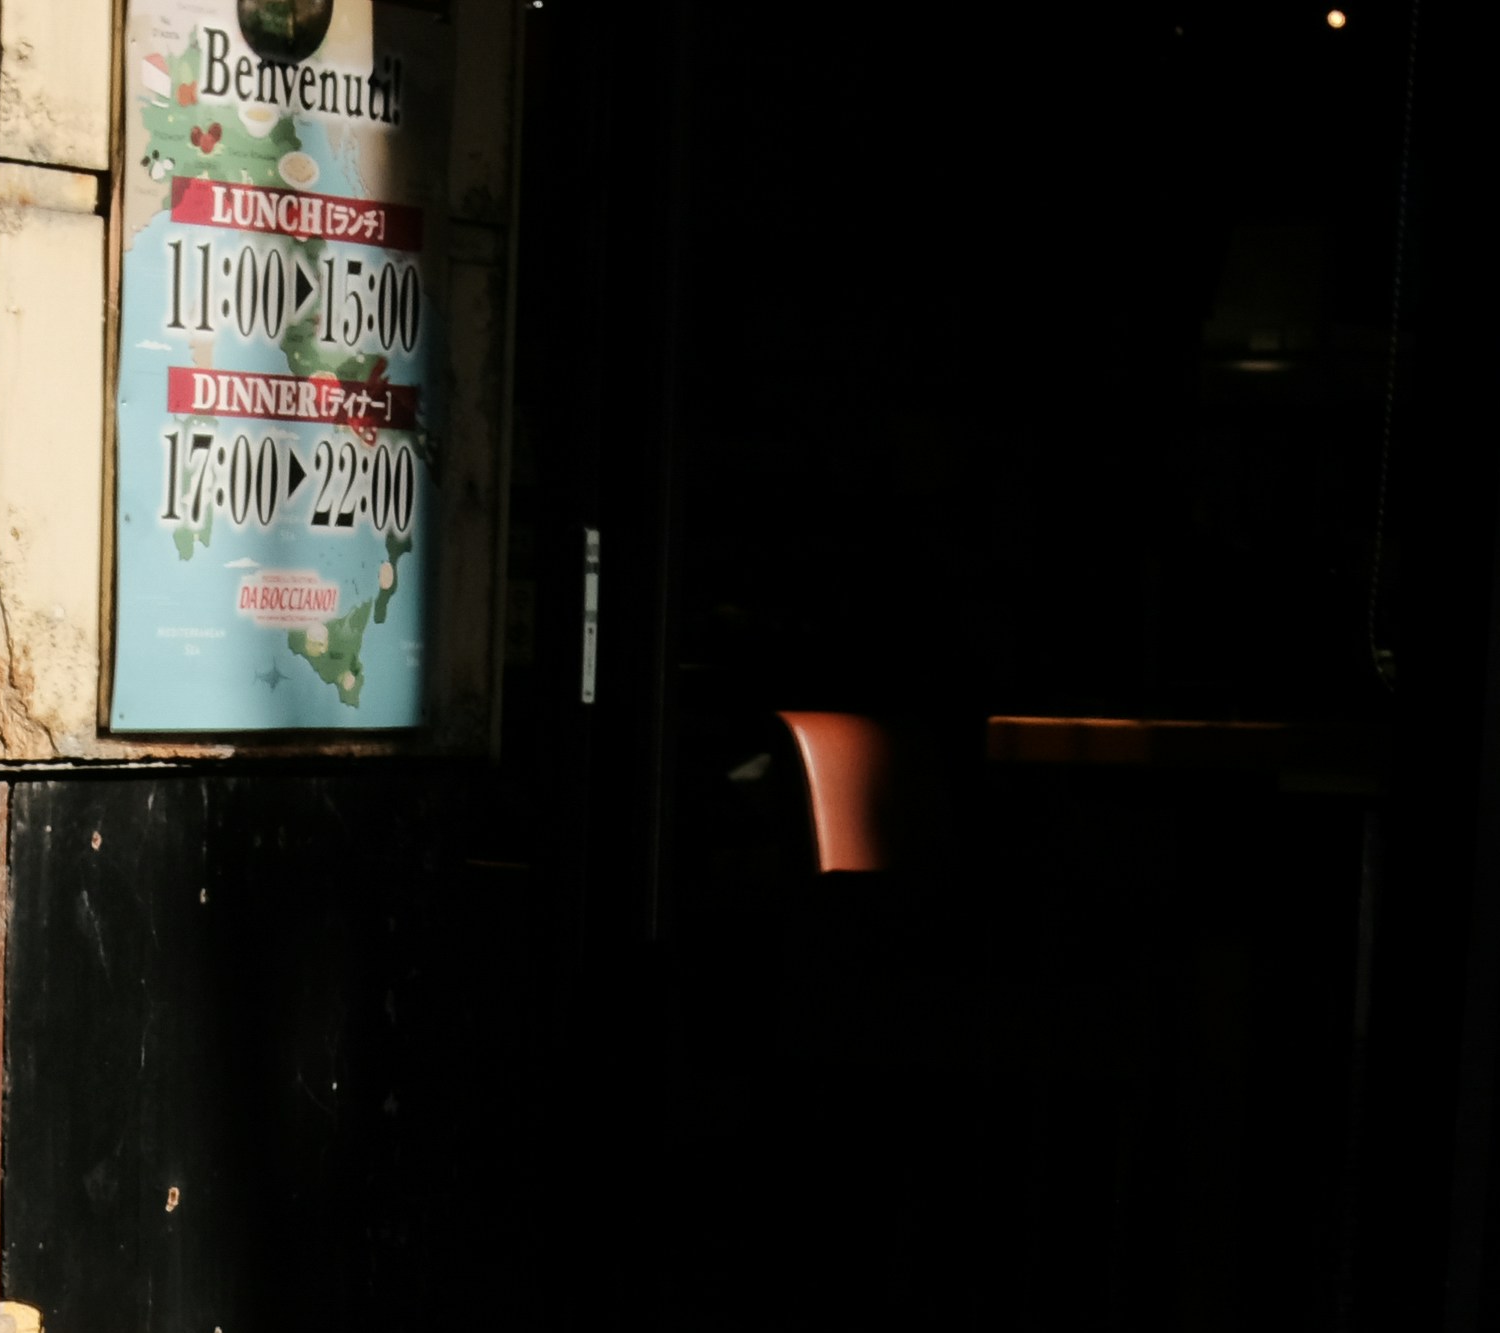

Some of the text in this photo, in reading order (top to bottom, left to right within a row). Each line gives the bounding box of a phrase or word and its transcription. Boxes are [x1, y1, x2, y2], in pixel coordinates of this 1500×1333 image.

[201, 26, 401, 126] Benvenuti!
[166, 239, 421, 354] 11:00 15:00
[161, 432, 415, 532] 17:00 22:00
